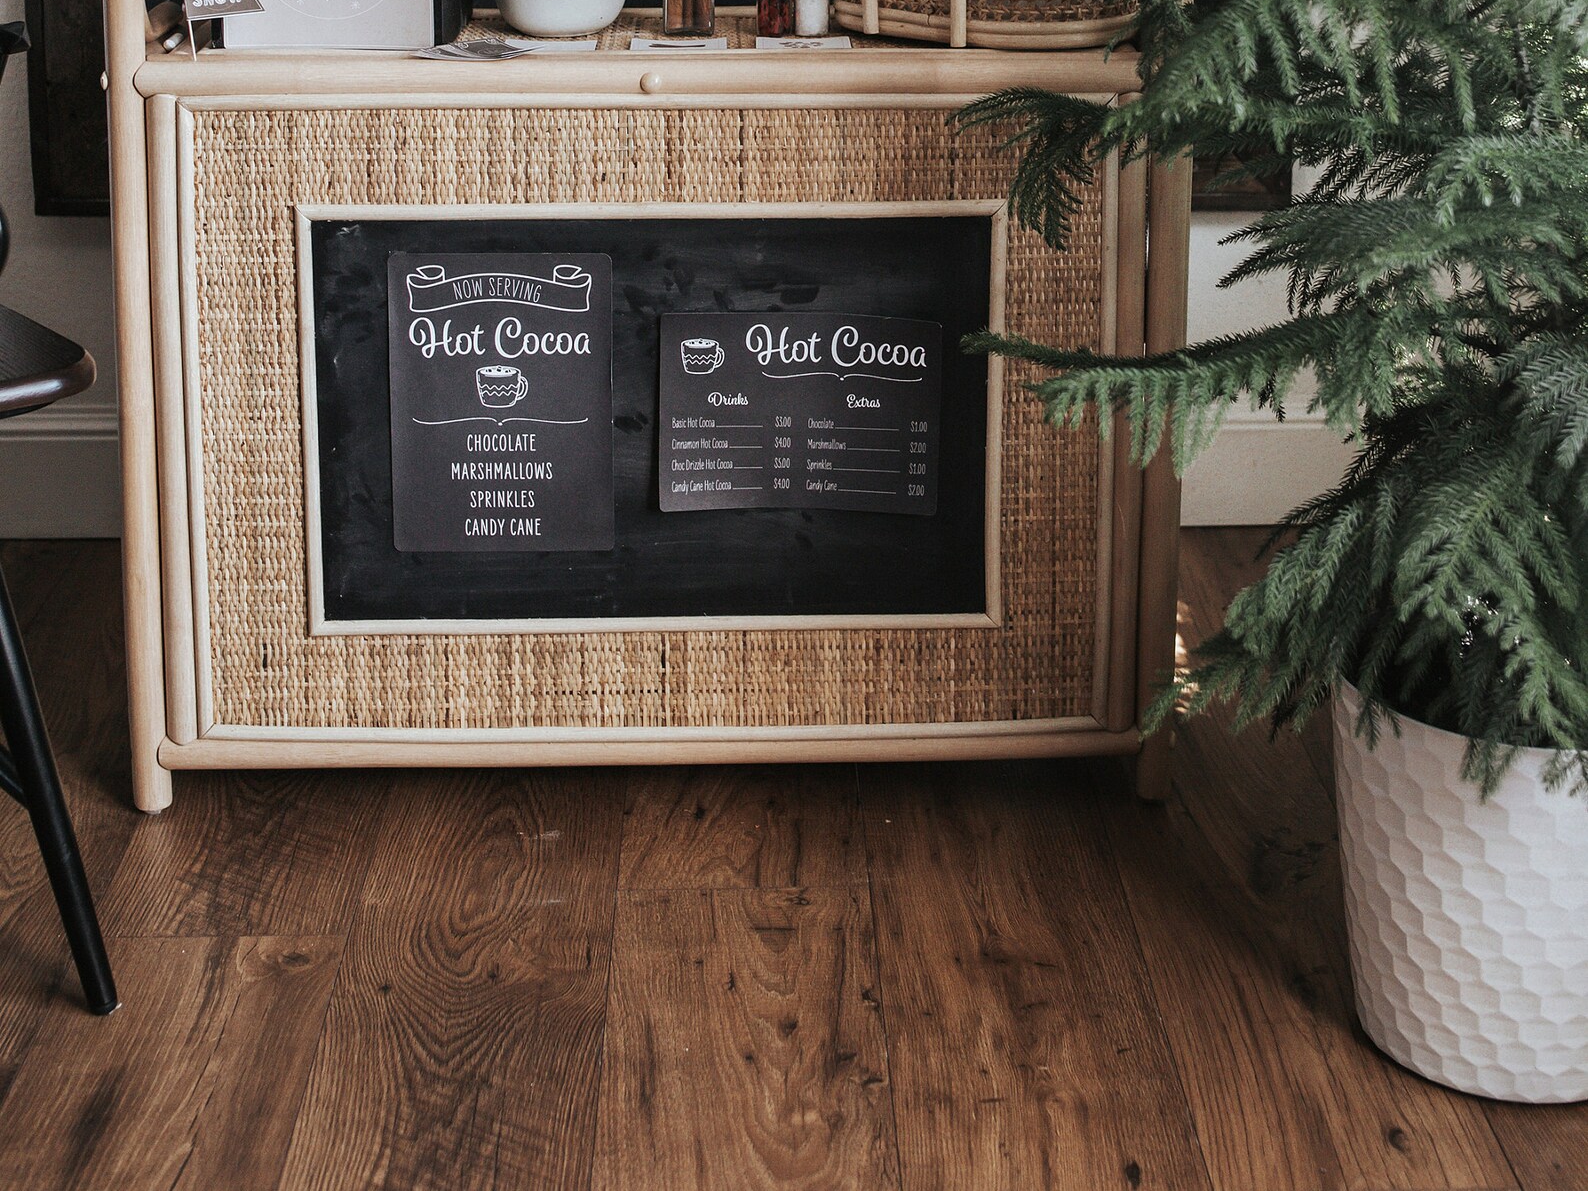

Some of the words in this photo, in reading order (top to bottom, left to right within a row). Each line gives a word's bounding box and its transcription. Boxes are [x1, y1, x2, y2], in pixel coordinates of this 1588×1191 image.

[452, 279, 484, 302] NOW
[489, 277, 543, 304] SERVING
[408, 316, 486, 359] Hot
[494, 316, 592, 359] Cocoa
[745, 324, 822, 365] Hot
[831, 325, 927, 368] Cocoa
[707, 391, 749, 407] Drinks
[846, 393, 881, 409] Extras
[671, 417, 686, 429] Basic
[687, 417, 698, 428] Hot
[699, 416, 716, 428] Cocoa
[807, 417, 835, 429] Chocolate
[910, 420, 928, 433] $1.00
[466, 434, 537, 452] CHOCOLATE
[671, 438, 700, 450] Cinnamon
[700, 438, 711, 449] Hot
[712, 437, 729, 449] Cocoa
[774, 436, 792, 448] $4.00
[807, 438, 847, 450] Marshmallows
[909, 441, 927, 454] $2.00
[451, 462, 554, 480] MARSHMALLOWS
[671, 459, 685, 471] Choc
[686, 458, 705, 470] Drizzle
[705, 458, 716, 470] Hot
[717, 458, 733, 470] Cocoa
[806, 459, 833, 473] Sprinkles
[908, 462, 926, 475] $1.00
[671, 480, 689, 495] Candy
[689, 480, 704, 491] Cane
[704, 479, 715, 491] Hot
[715, 479, 732, 491] Cocoa
[773, 477, 790, 489] $4.00
[805, 479, 823, 494] Candy
[823, 479, 838, 491] Cane
[907, 483, 925, 496] $2.00
[469, 490, 536, 508] SPRINKLES
[464, 518, 505, 536] CANDY
[509, 518, 542, 536] CANE
